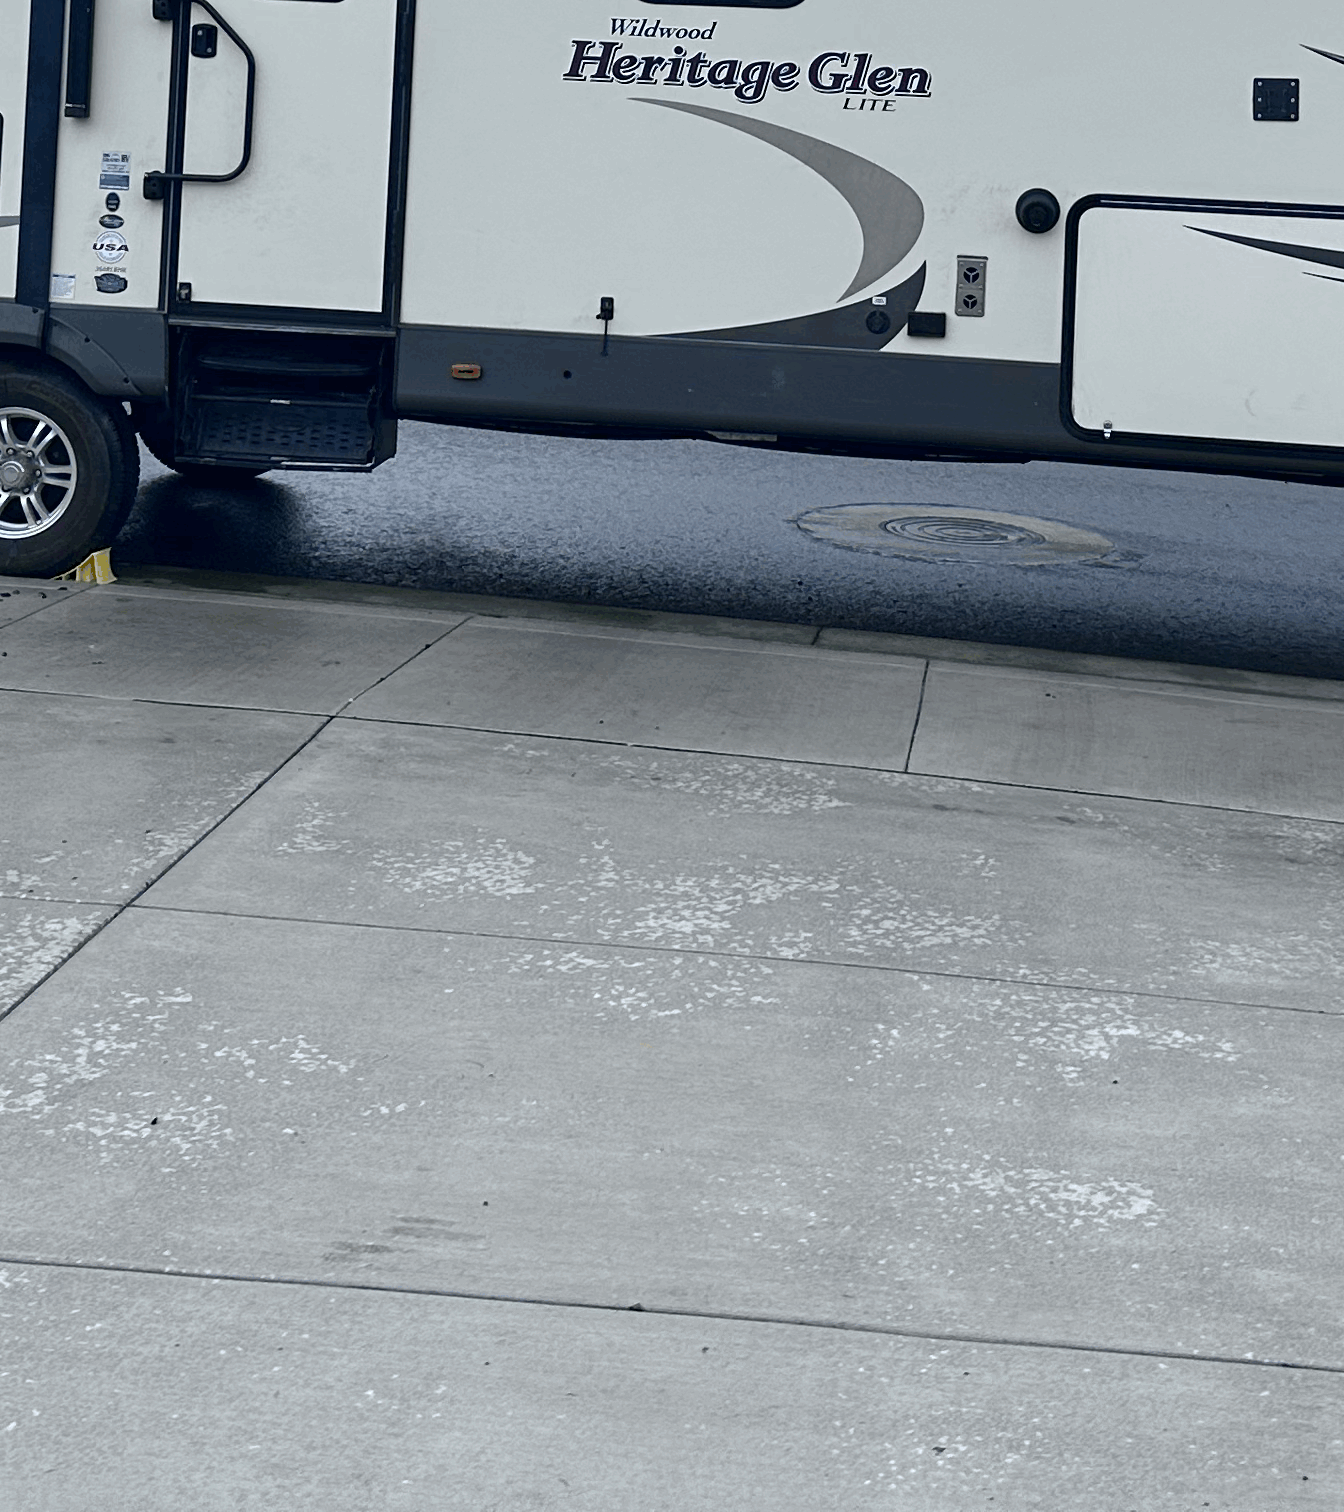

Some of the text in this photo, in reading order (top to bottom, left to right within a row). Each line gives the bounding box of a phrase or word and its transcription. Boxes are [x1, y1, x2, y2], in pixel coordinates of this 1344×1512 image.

[609, 18, 717, 41] Wildwood
[563, 39, 932, 104] Heritage Glen
[843, 97, 897, 113] LITE
[92, 242, 129, 252] USA
